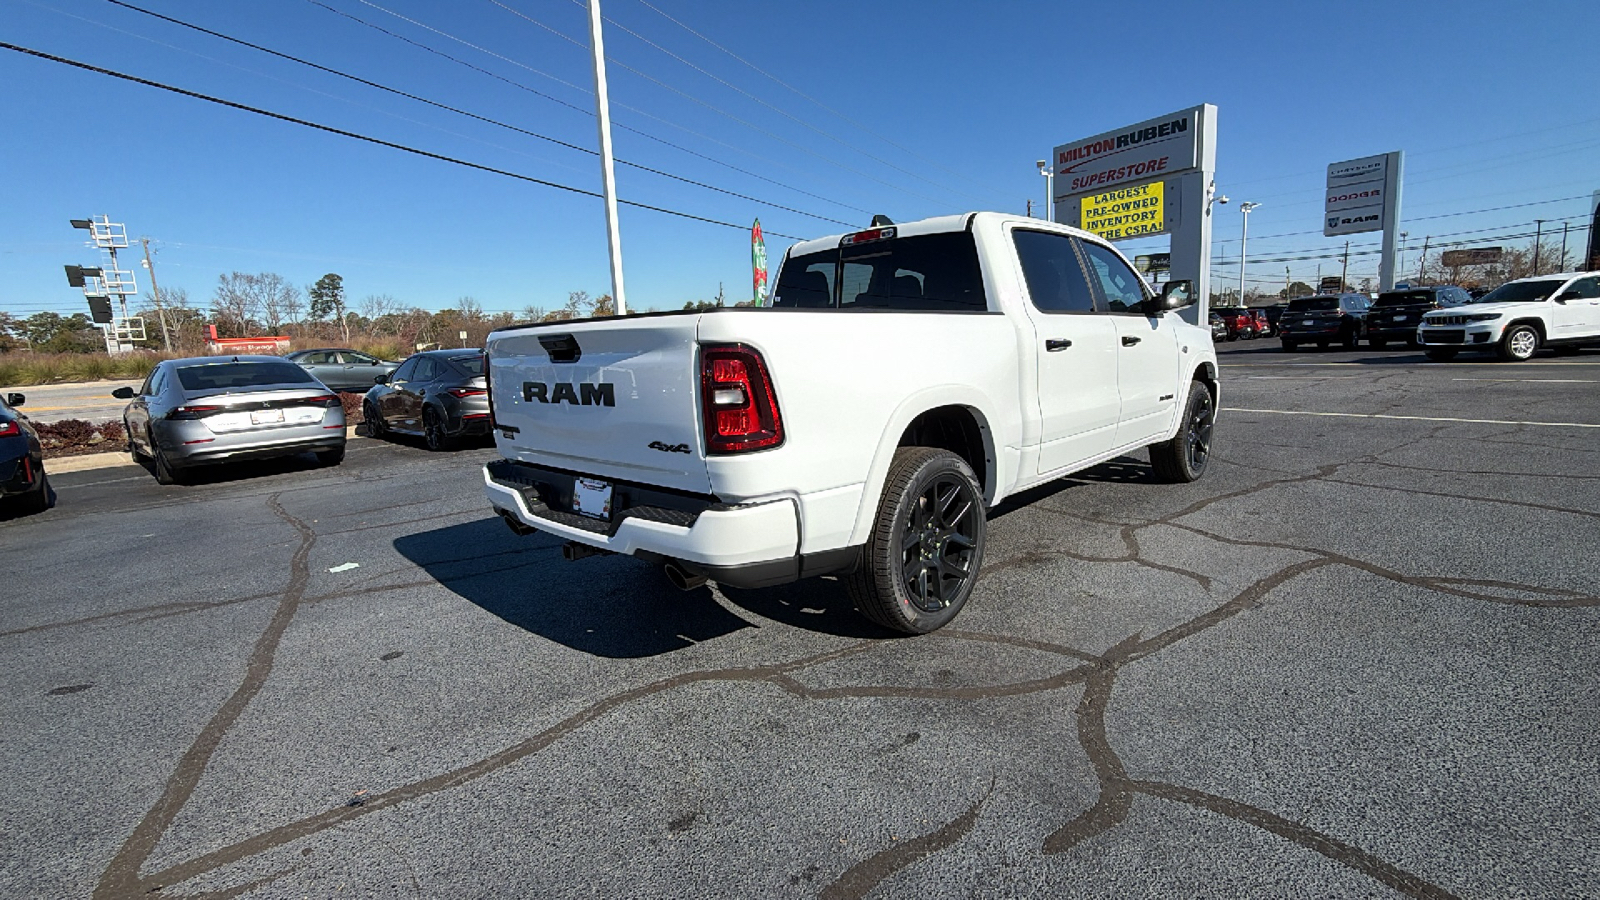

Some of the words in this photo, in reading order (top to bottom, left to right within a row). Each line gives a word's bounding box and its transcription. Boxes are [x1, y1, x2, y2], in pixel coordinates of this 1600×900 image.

[1059, 138, 1115, 164] MILTON
[1116, 118, 1188, 148] RUBEN
[1071, 156, 1169, 190] SUPERSTORE
[1094, 185, 1149, 204] LARGEST
[1328, 189, 1381, 203] DODGE
[1086, 196, 1159, 218] PRE-OWNED
[1086, 210, 1158, 230] INVENTORY
[1341, 214, 1379, 225] RAM
[1098, 228, 1122, 239] THE
[1124, 221, 1163, 236] CSRA!
[523, 381, 616, 408] RAM
